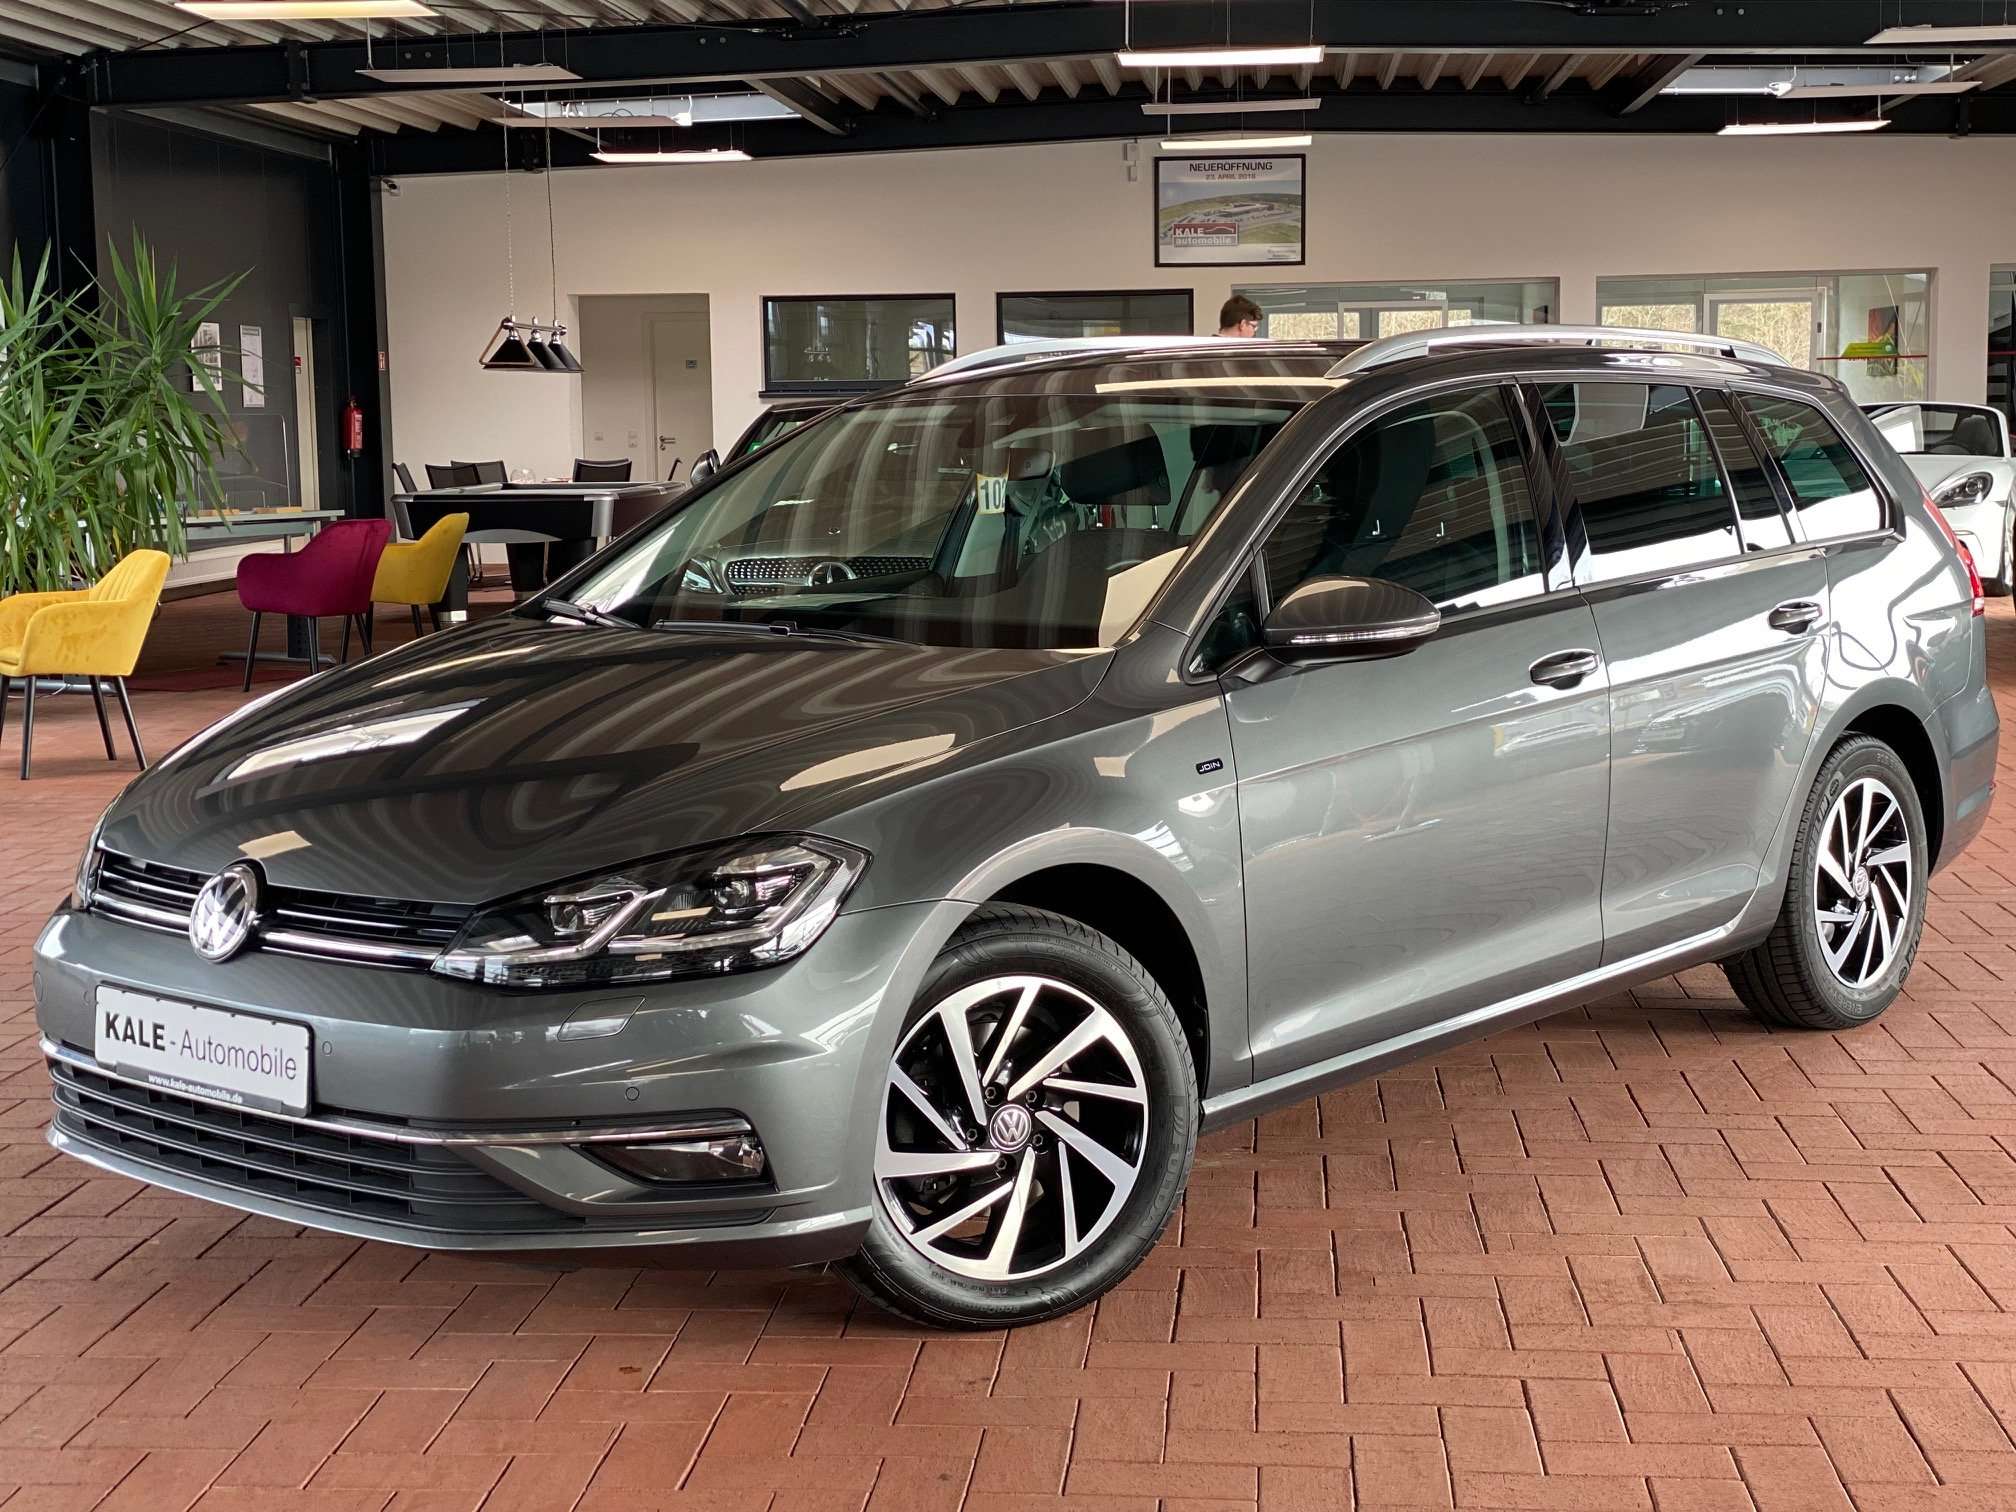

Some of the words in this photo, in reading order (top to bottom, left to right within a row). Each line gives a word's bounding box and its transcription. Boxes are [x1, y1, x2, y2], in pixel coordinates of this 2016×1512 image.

[1175, 227, 1204, 236] KALE
[1175, 235, 1232, 245] automobile
[1199, 760, 1221, 772] JOIN
[148, 1073, 243, 1104] www.kale-automobile.de
